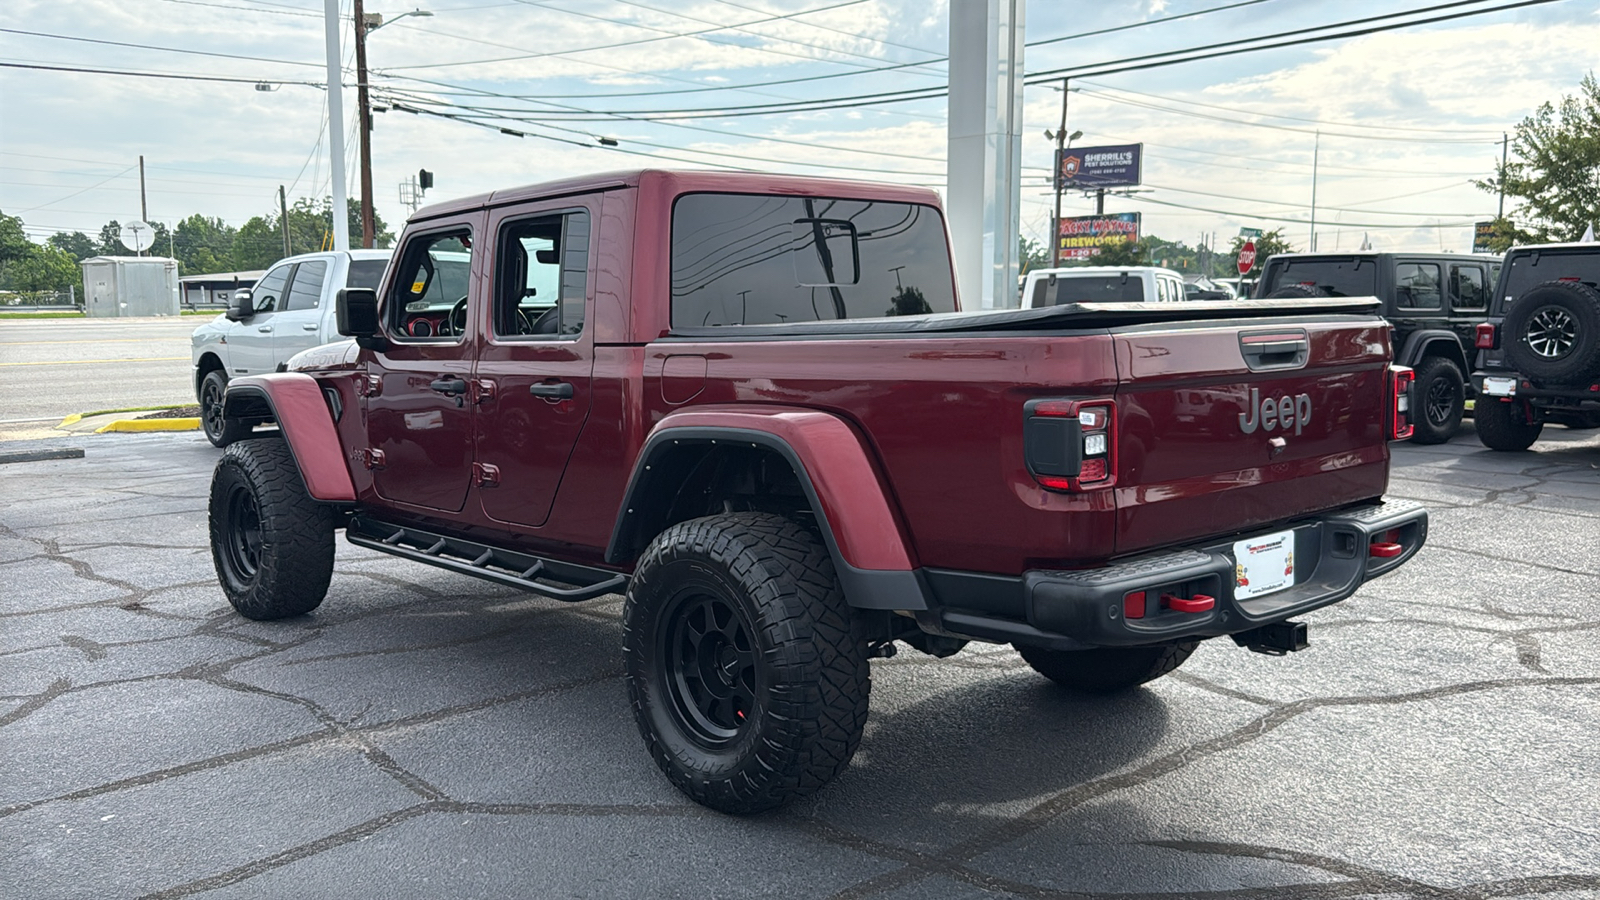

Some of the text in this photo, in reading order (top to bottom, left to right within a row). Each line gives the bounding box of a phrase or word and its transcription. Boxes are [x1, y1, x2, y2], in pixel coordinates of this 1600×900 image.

[1085, 152, 1132, 162] SHERRILL'S
[1060, 220, 1091, 234] ACKY
[1061, 235, 1126, 248] FIREWORKS
[1239, 251, 1254, 264] STOP
[1238, 388, 1311, 436] Jeep
